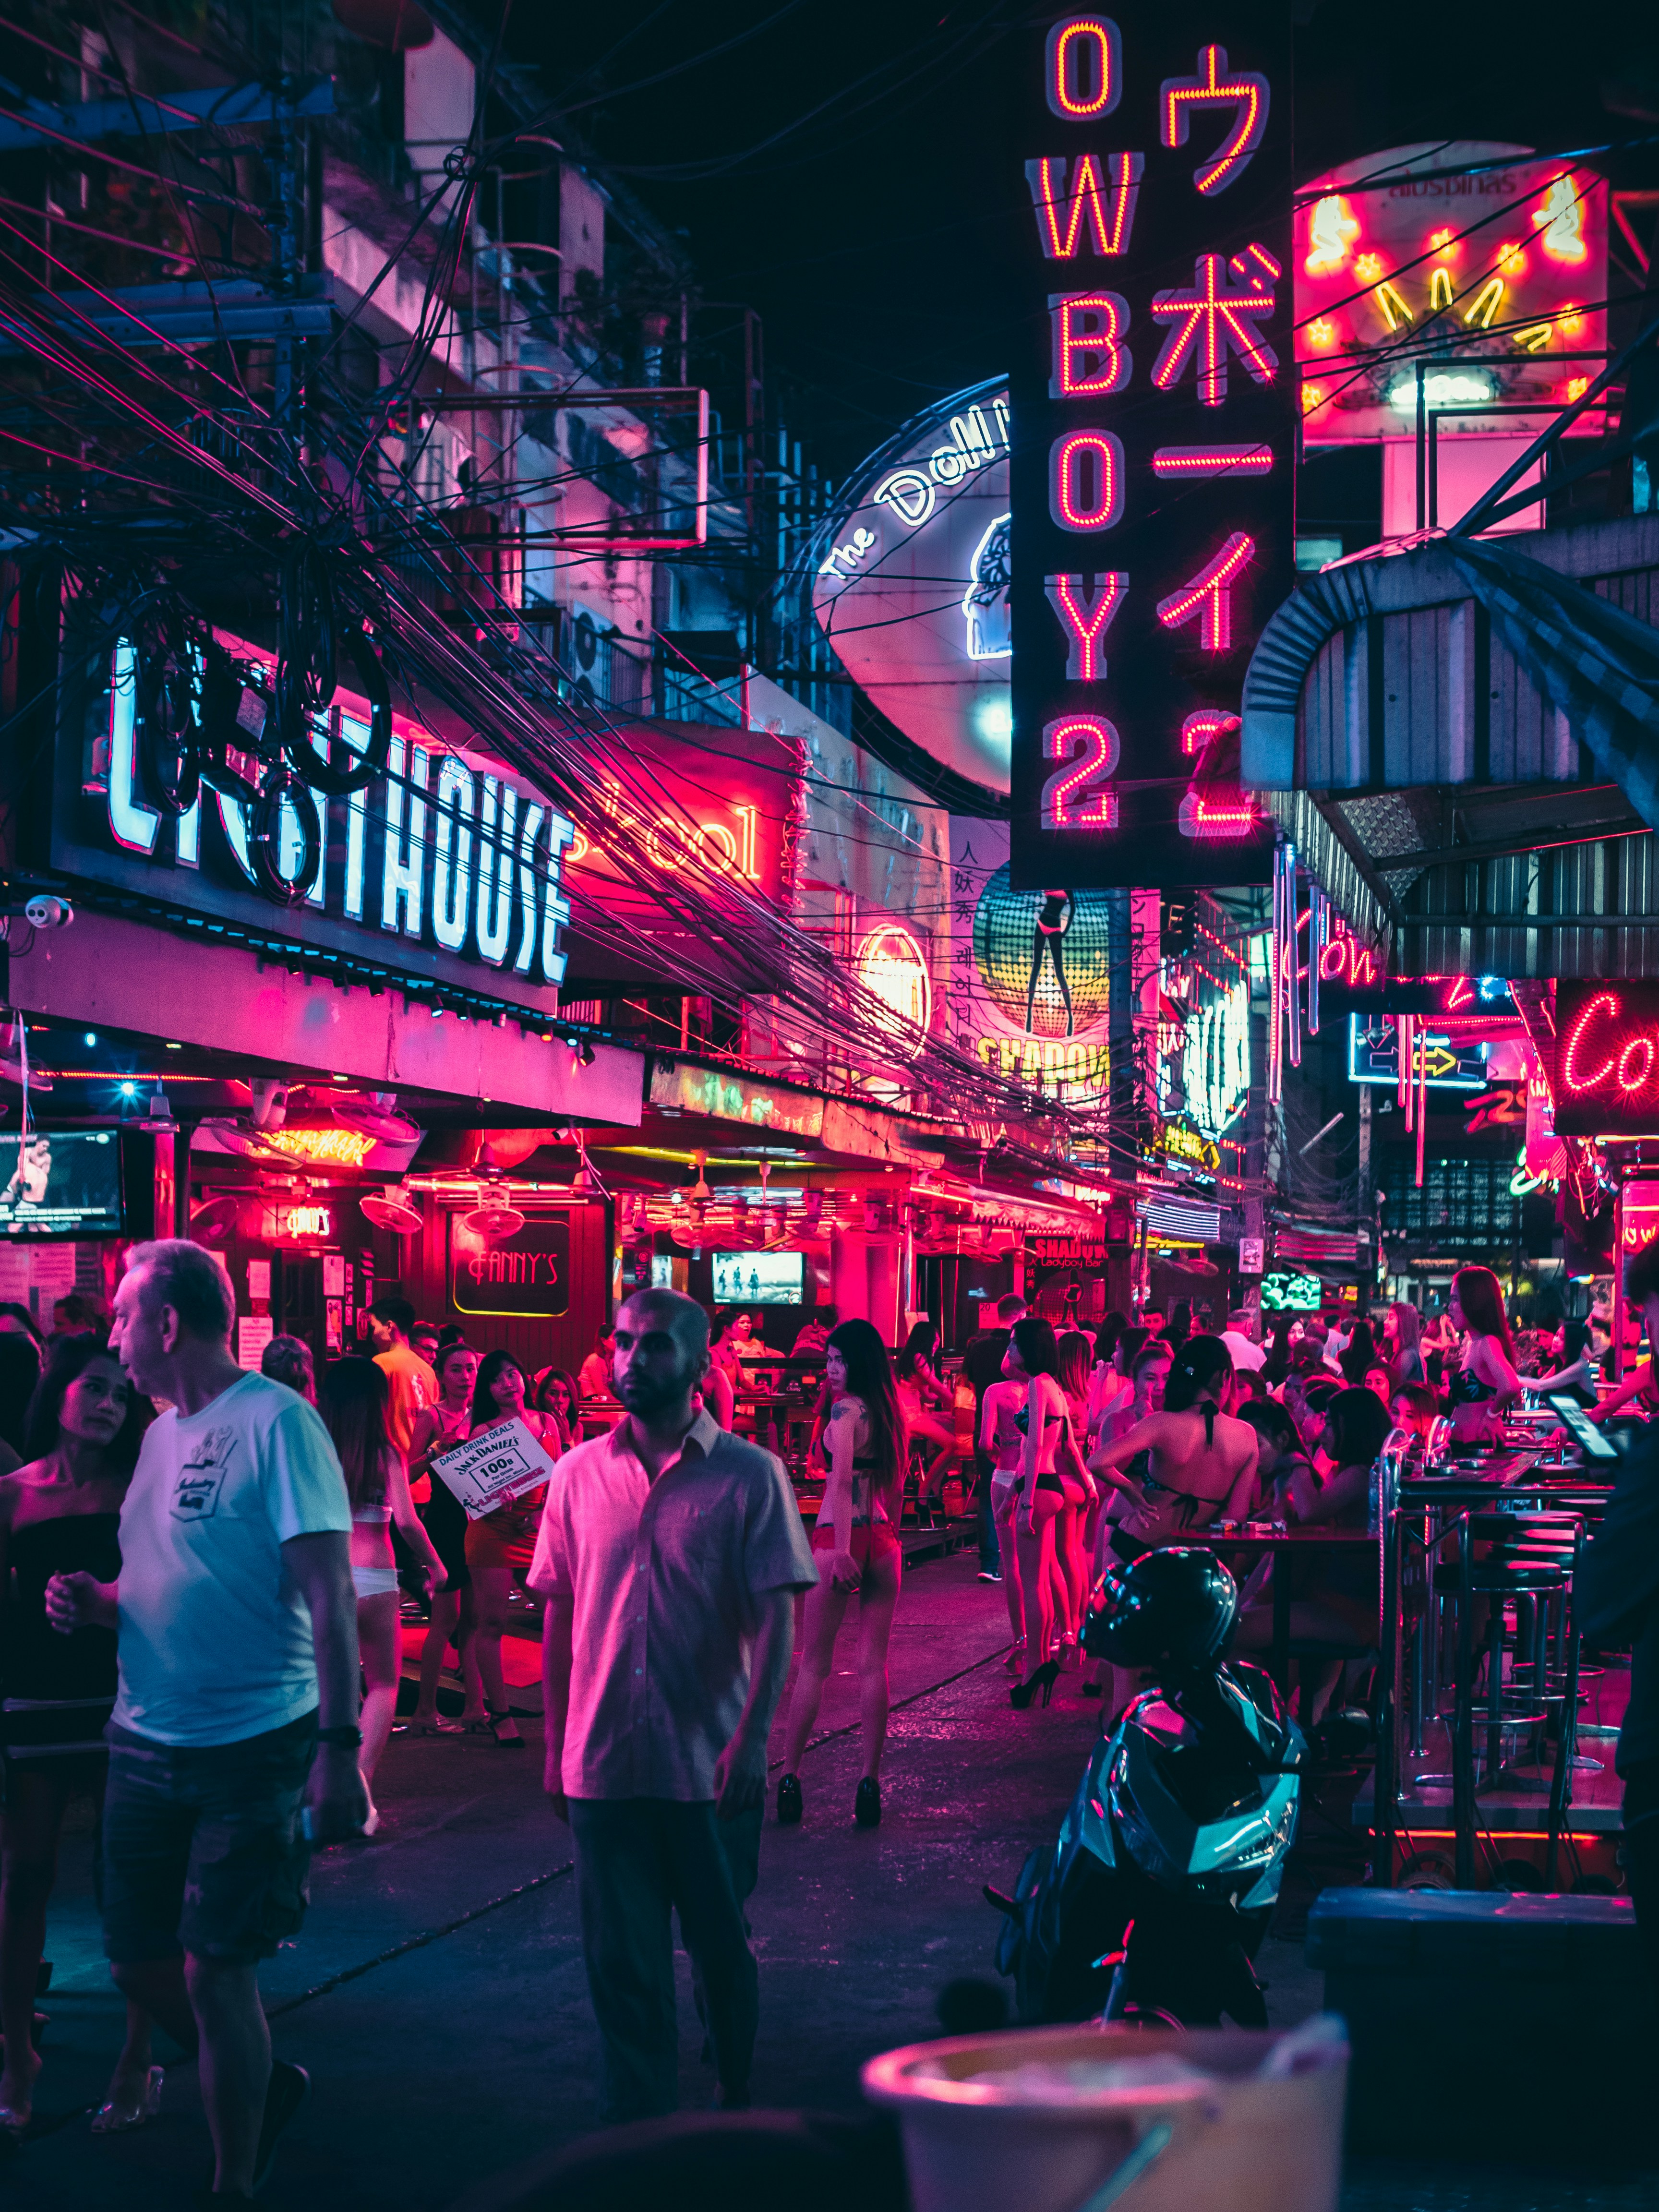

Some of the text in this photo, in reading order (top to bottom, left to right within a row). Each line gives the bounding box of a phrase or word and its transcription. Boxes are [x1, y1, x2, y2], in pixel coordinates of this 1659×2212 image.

[818, 528, 875, 579] The
[954, 841, 978, 924] 人妖秀
[1035, 1238, 1109, 1259] SHADOW
[1041, 1258, 1083, 1269] Ladyboy
[468, 1251, 558, 1286] FANNY'S
[439, 1423, 514, 1466] DAILY DRINK DEALS
[454, 1455, 480, 1475] JACK
